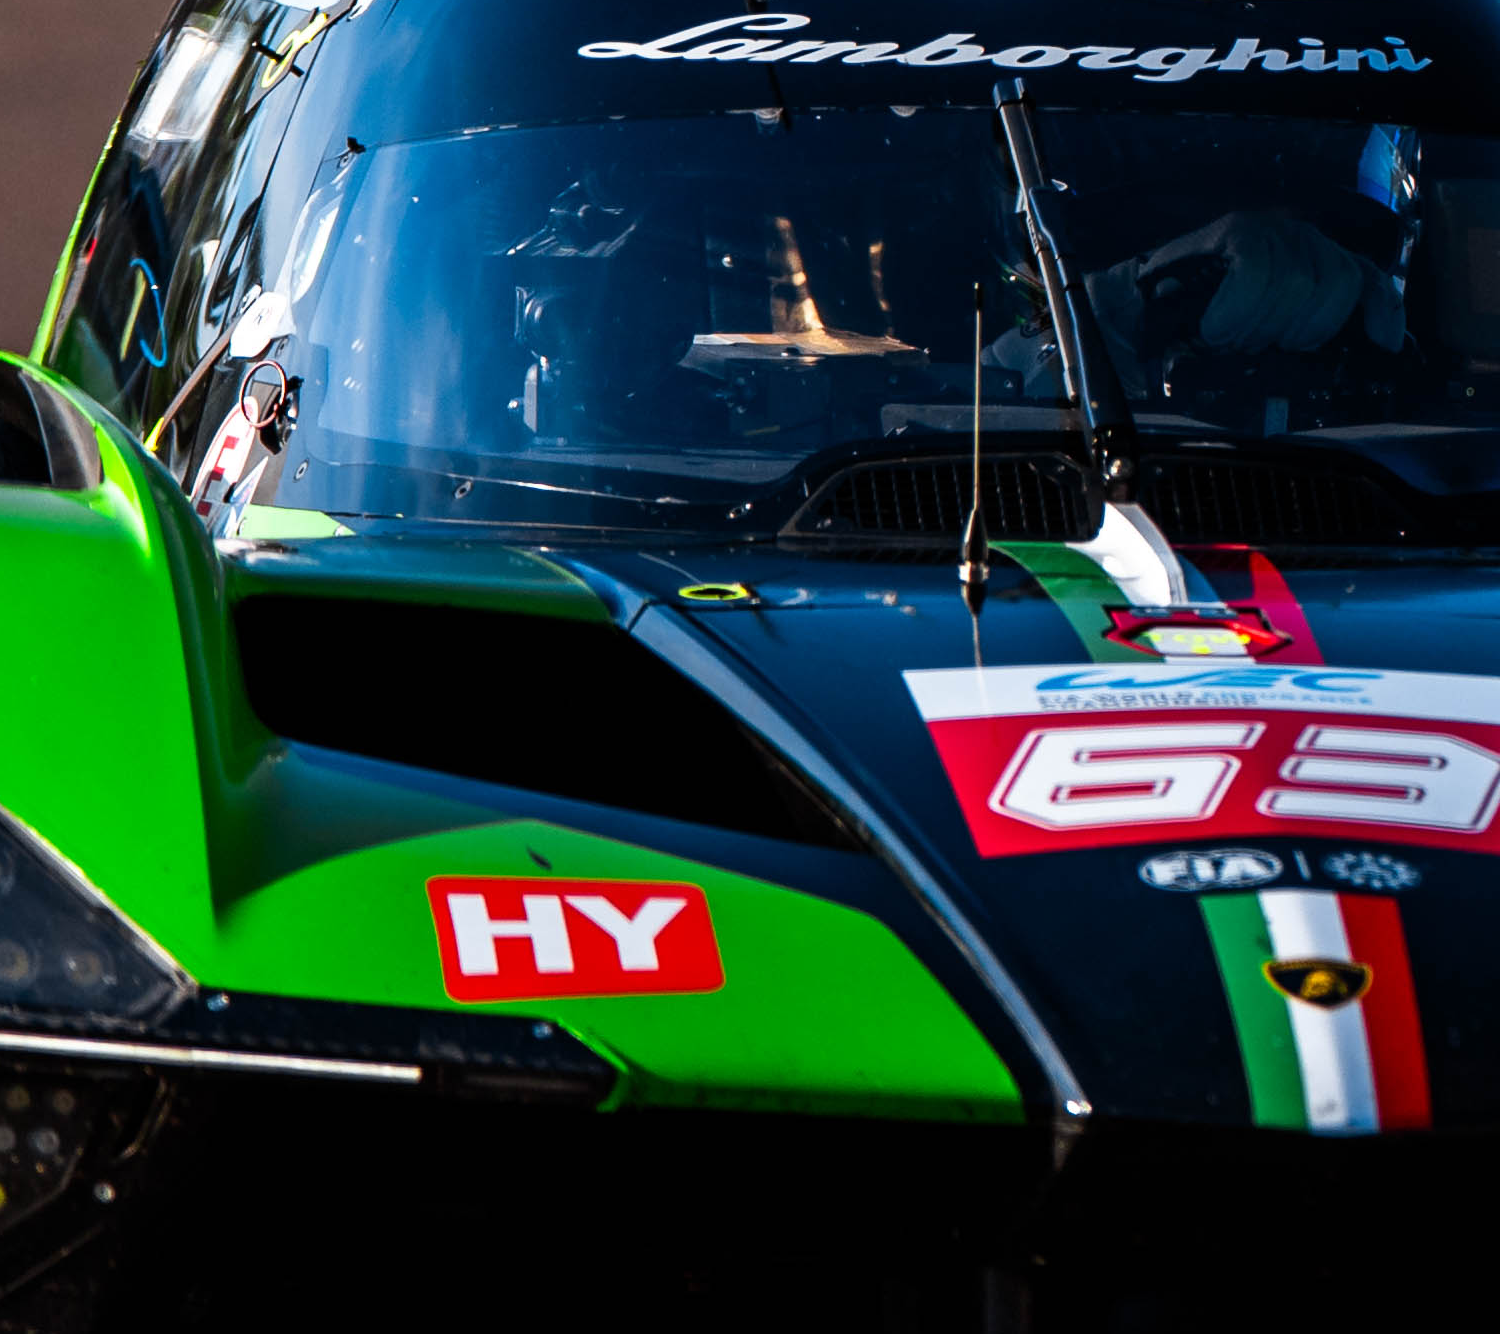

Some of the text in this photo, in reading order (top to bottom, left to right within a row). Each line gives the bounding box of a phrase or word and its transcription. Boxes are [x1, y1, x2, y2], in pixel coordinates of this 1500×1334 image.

[578, 13, 1433, 82] Lamborghini
[1145, 853, 1273, 887] FIA
[446, 893, 688, 976] HY
